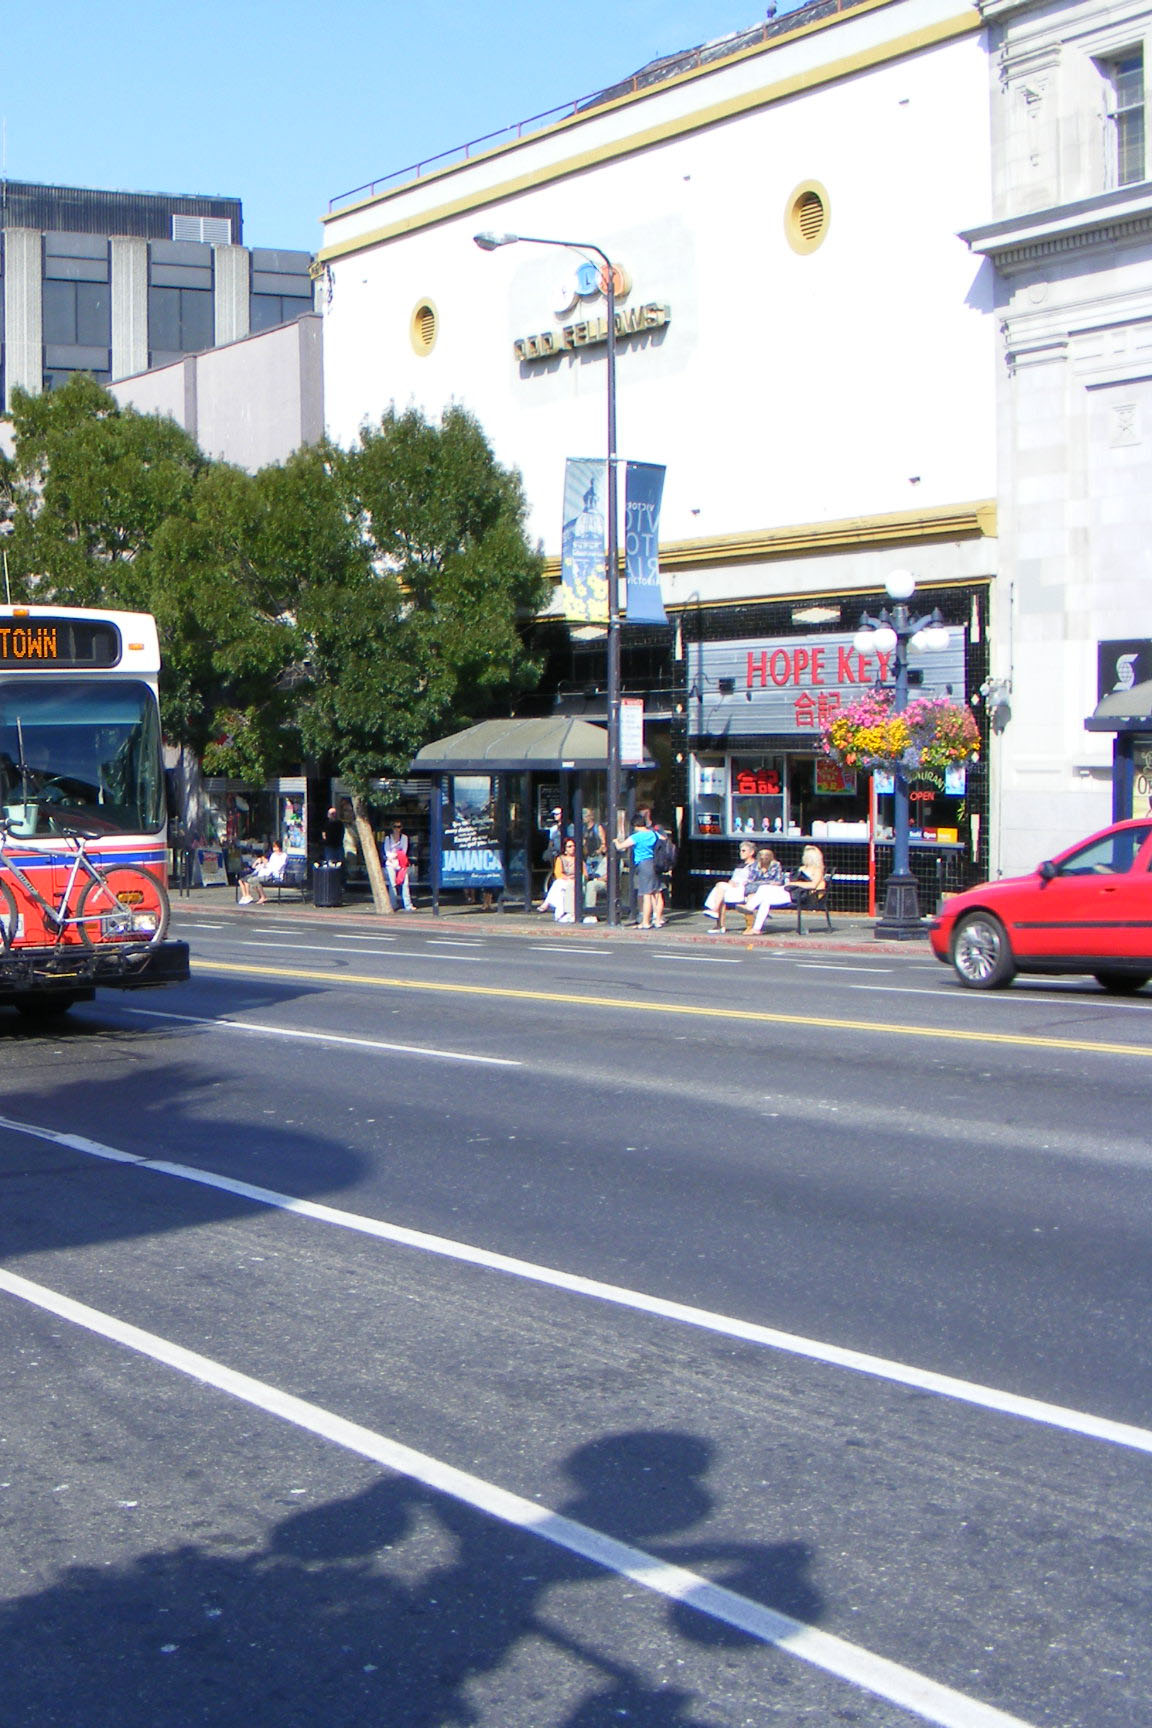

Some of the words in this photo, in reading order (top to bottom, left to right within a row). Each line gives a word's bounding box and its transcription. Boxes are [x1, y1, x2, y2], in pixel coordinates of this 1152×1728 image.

[512, 331, 560, 361] ODD
[562, 302, 670, 350] FELLOWS
[746, 647, 826, 688] HOPE
[836, 645, 894, 683] KEY
[909, 790, 935, 801] OPEN
[441, 849, 503, 871] JAMAICA
